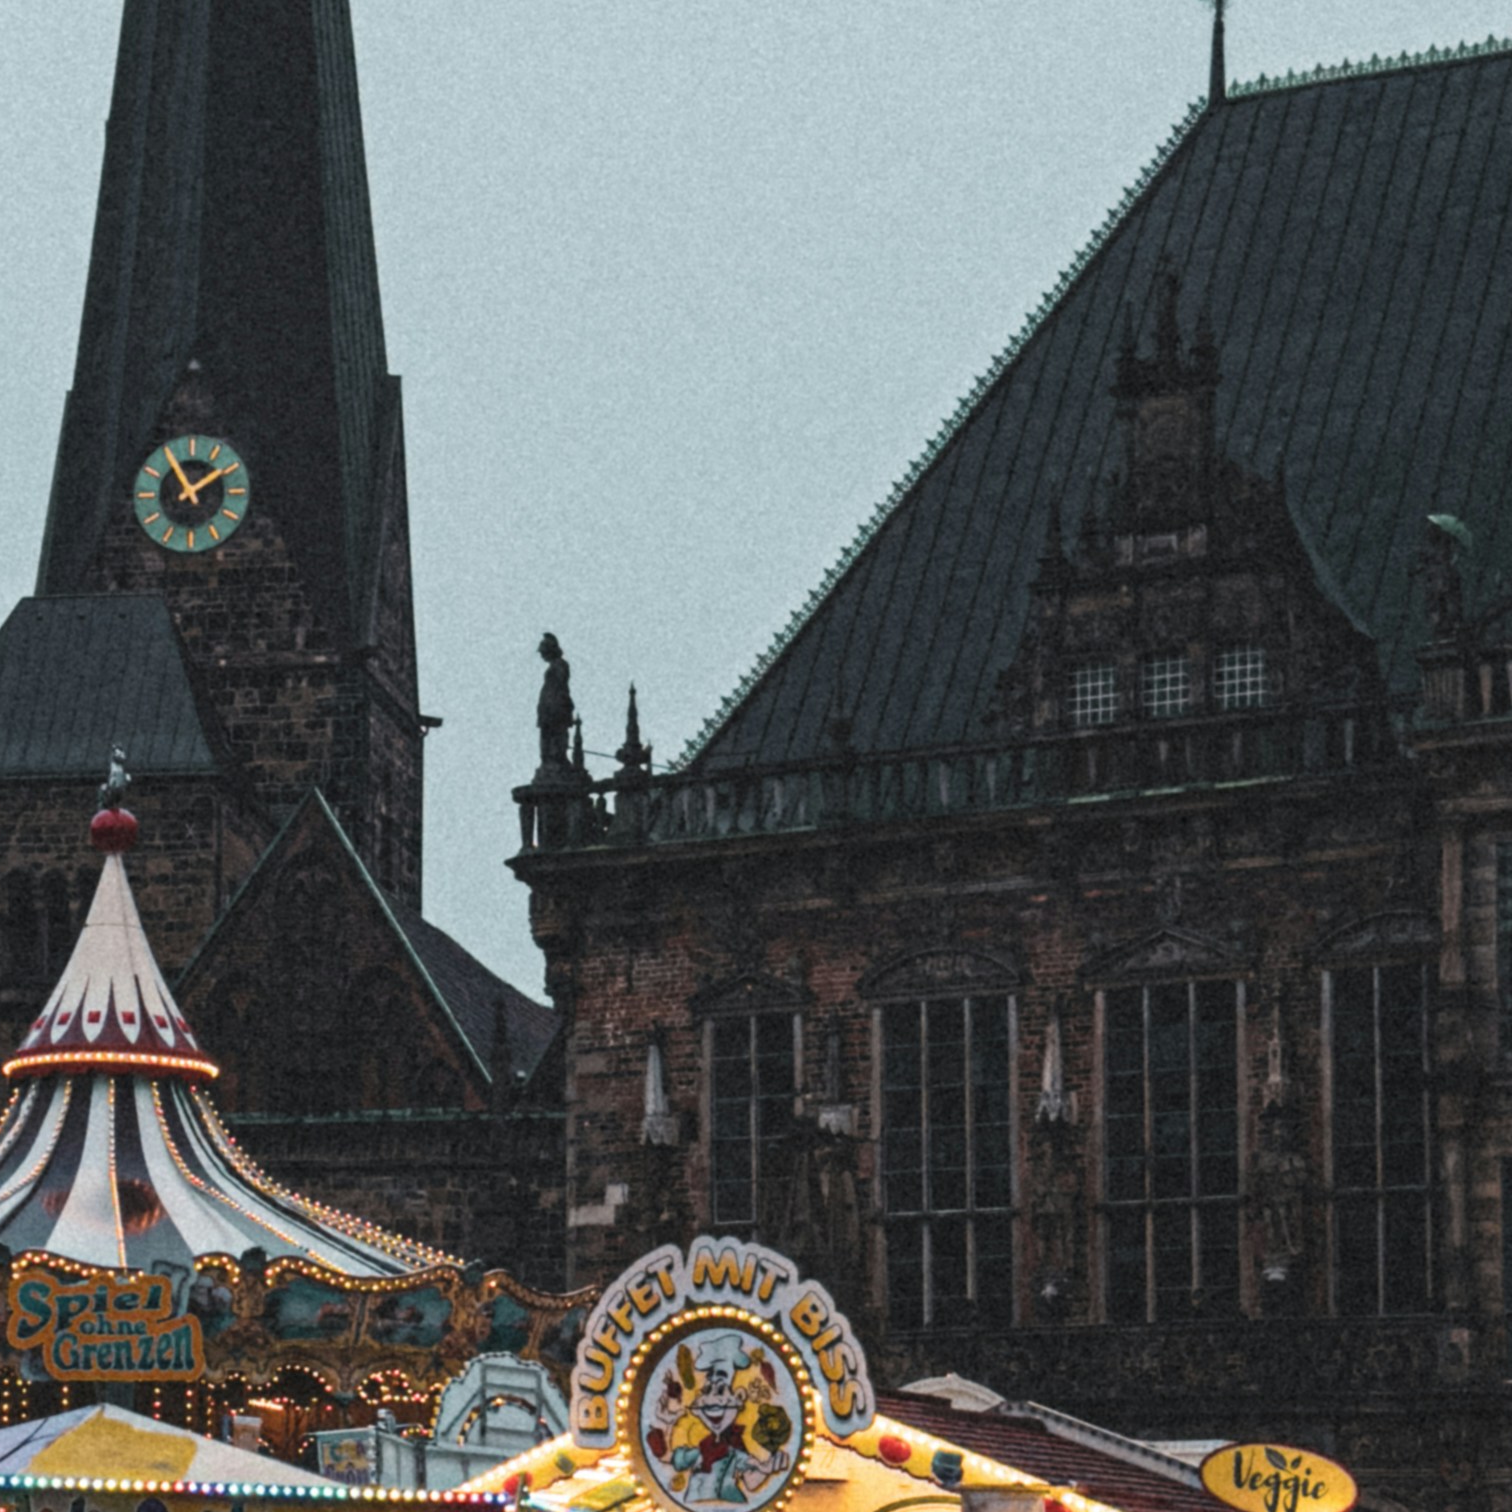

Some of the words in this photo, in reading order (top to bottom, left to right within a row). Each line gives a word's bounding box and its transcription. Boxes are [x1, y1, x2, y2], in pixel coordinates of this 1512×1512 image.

[16, 1281, 164, 1338] Spiel
[79, 1312, 147, 1336] ohne
[52, 1326, 196, 1372] Grenzen
[578, 1255, 677, 1433] BUFFET
[691, 1244, 790, 1302] MIT
[789, 1290, 868, 1420] BISS
